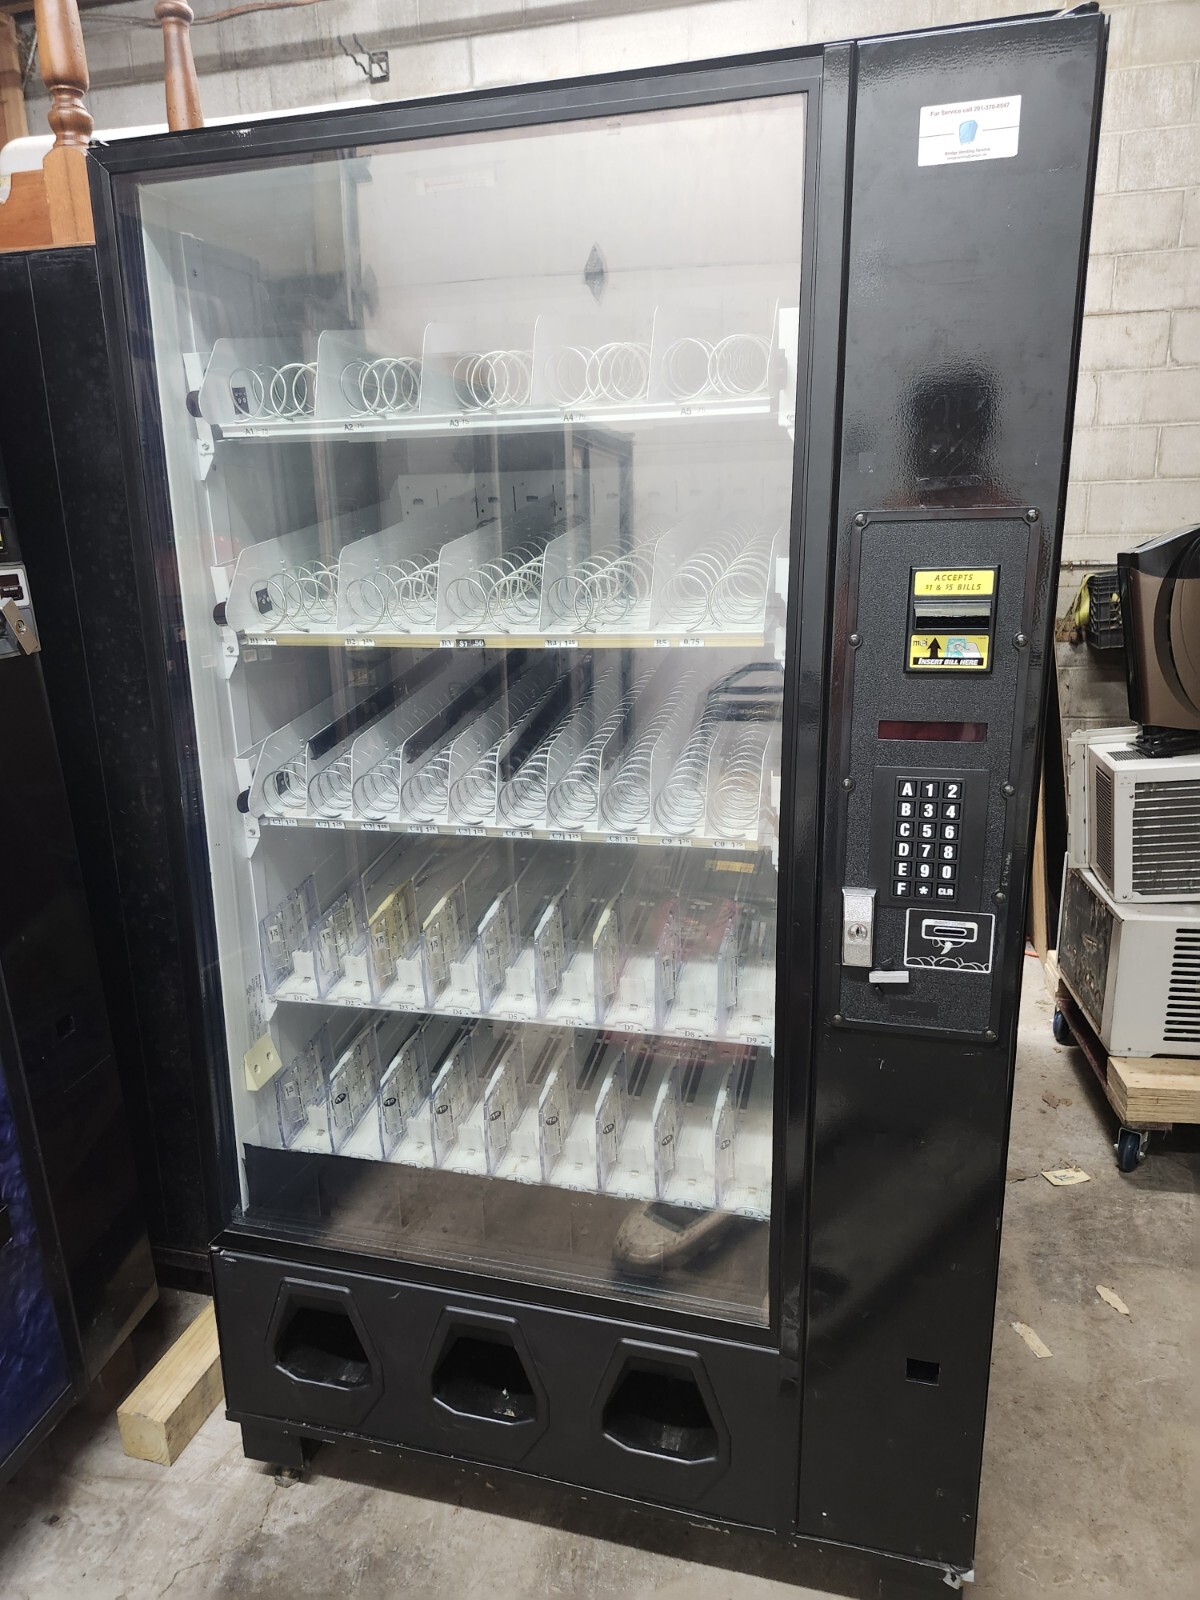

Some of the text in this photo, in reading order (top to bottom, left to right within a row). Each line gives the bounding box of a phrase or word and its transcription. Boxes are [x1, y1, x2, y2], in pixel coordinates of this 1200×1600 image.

[563, 413, 573, 421] A4
[902, 782, 958, 798] A 1 2
[901, 803, 955, 818] B 3 4
[900, 823, 954, 839] C 5 6
[899, 843, 953, 859] D 7 8
[898, 863, 951, 878] E 9 0
[897, 883, 906, 895] F
